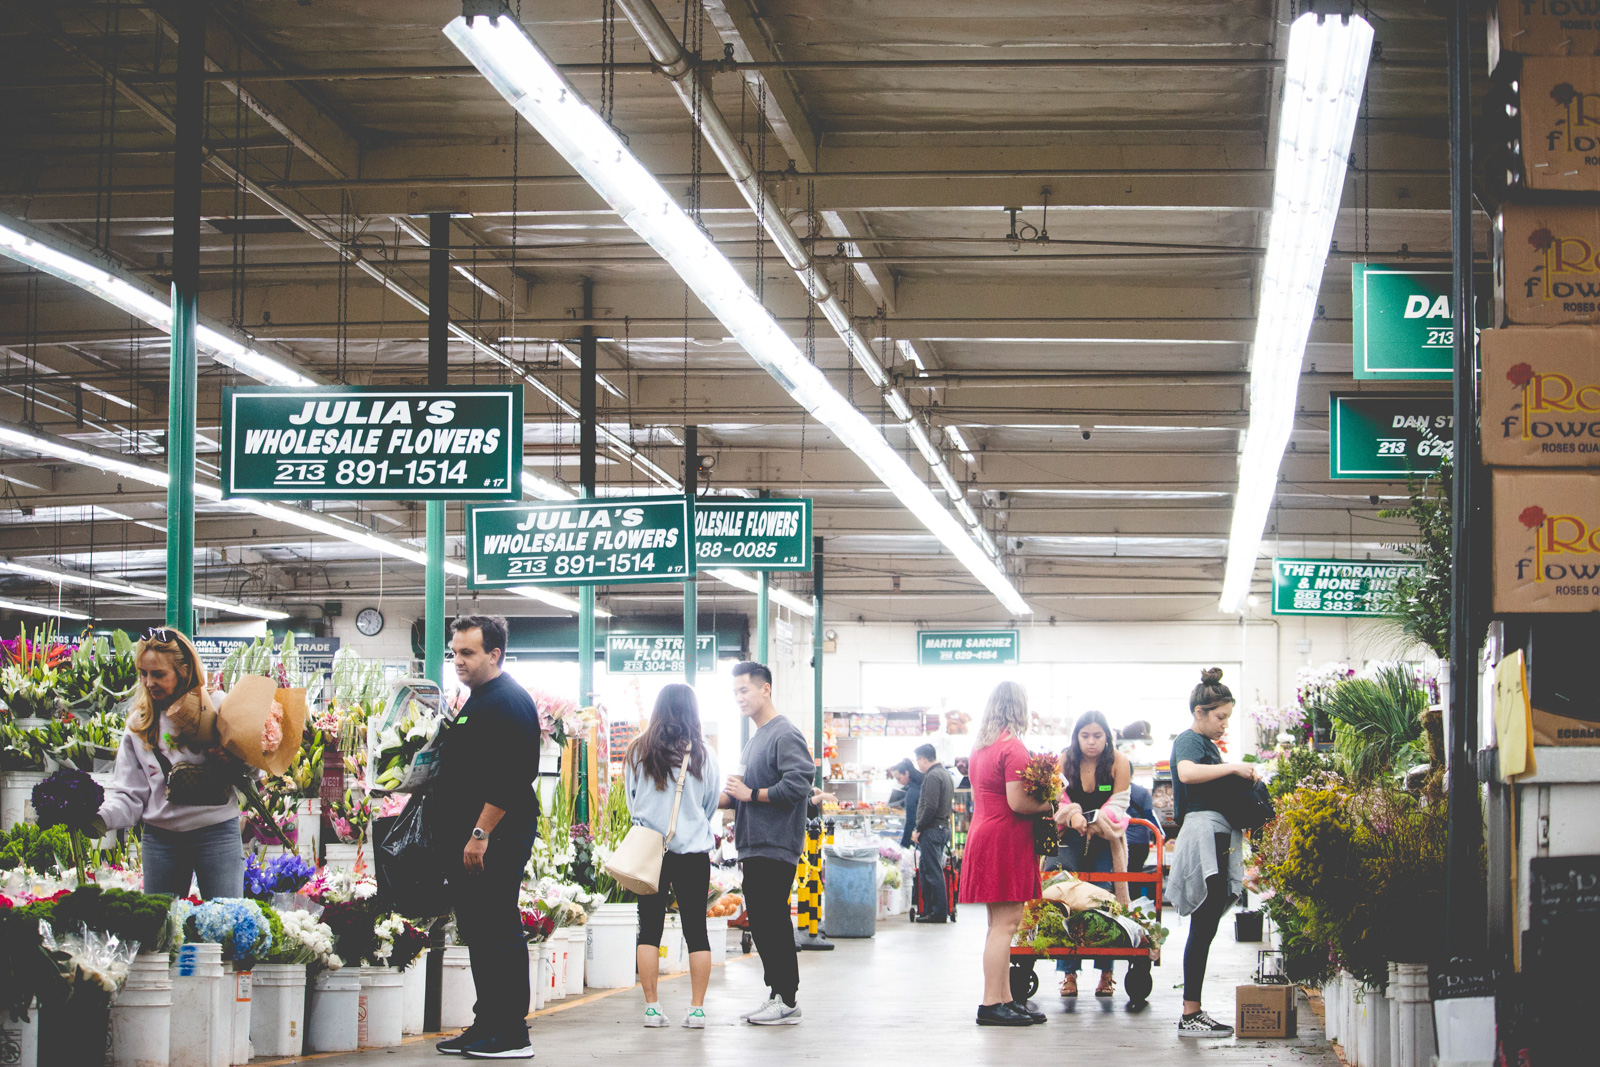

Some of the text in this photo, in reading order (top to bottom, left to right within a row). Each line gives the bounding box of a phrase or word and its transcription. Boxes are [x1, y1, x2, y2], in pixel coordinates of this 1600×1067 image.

[1403, 294, 1454, 319] DA
[1563, 302, 1595, 312] ROSES
[1426, 330, 1454, 345] 213
[288, 400, 457, 425] JULIA'S
[1392, 415, 1430, 428] DAN
[244, 428, 501, 455] WHOLESALE FLOWERS
[1378, 441, 1406, 454] 213
[1541, 443, 1600, 454] ROSES QUA
[275, 459, 468, 485] 213 891-1514
[516, 508, 645, 531] JULIA'S
[695, 510, 799, 537] OLESALE FLOWERS
[483, 528, 679, 555] WHOLESALE FLOWERS
[508, 553, 656, 575] 213 891-1514
[1283, 564, 1316, 577] THE
[1298, 577, 1310, 589] &
[1315, 579, 1360, 590] MORE
[1555, 586, 1589, 595] ROSES
[612, 638, 651, 650] WALL
[925, 637, 1012, 649] MARTIN SANCHEZ
